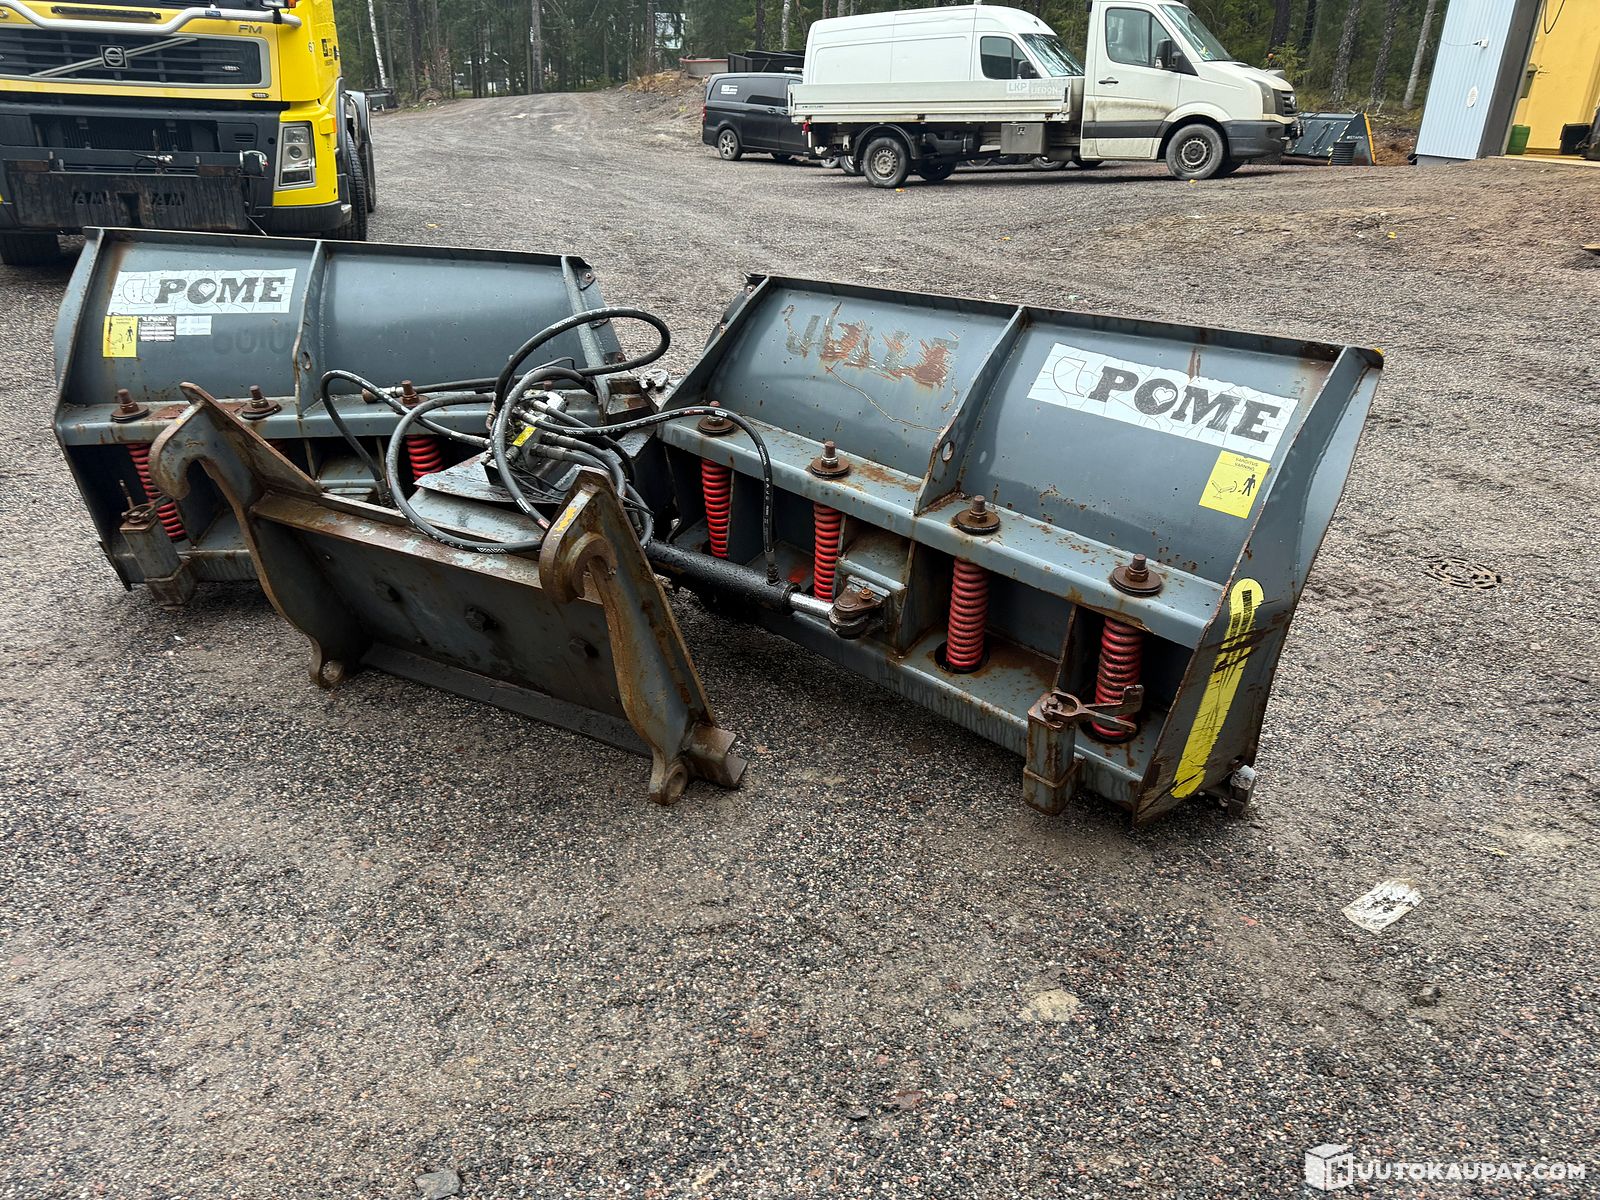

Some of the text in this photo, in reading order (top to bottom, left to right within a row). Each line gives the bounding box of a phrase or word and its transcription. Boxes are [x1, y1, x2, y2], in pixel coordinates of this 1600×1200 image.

[1008, 82, 1027, 92] LKP
[154, 277, 286, 304] POME
[1088, 366, 1281, 442] POME
